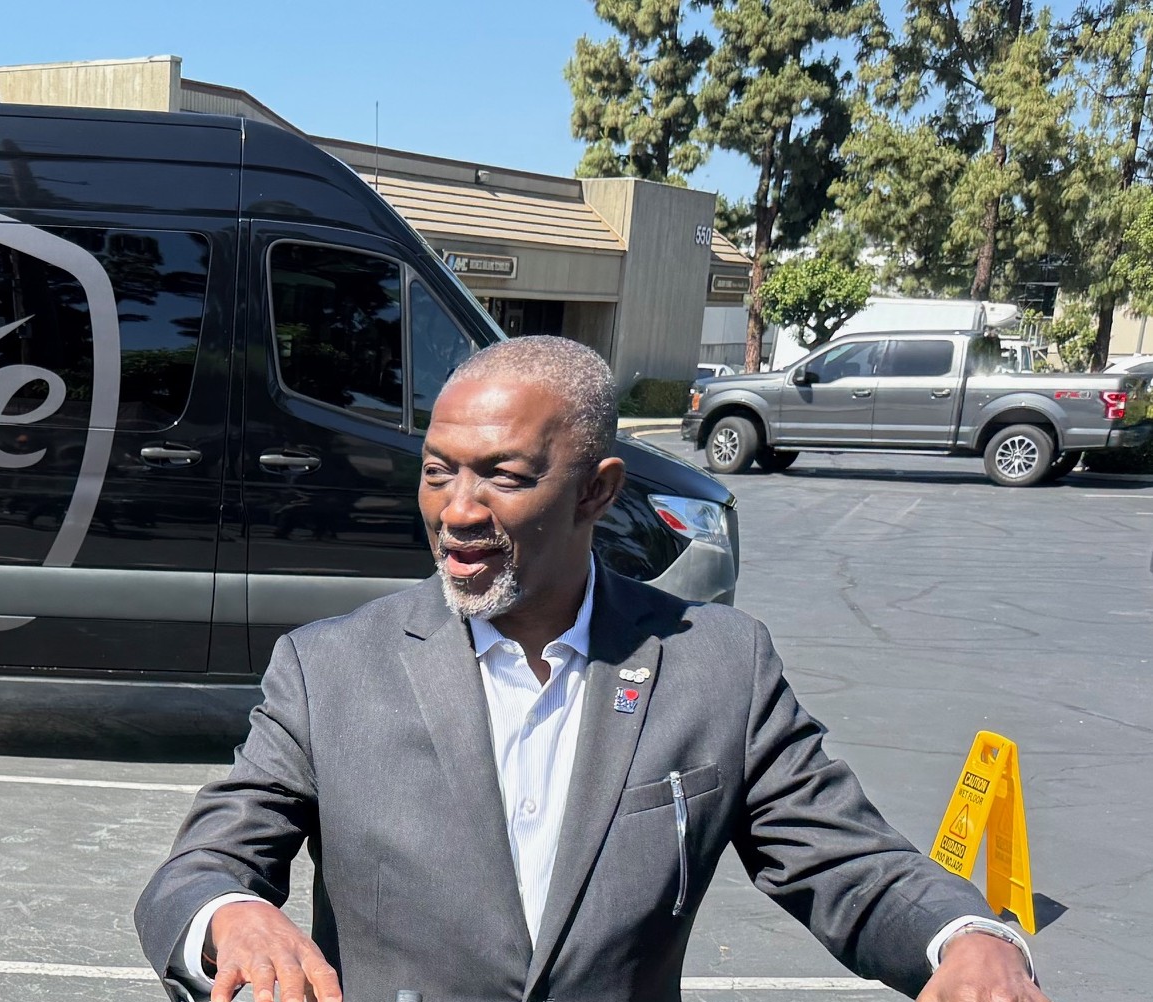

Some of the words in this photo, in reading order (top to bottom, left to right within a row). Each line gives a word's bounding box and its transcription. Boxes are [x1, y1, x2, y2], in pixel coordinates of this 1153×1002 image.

[695, 225, 712, 245] 550
[964, 772, 989, 792] CAUTION
[968, 792, 984, 805] FLOOR
[942, 837, 966, 858] CUIDADO
[945, 856, 964, 873] MOJADO
